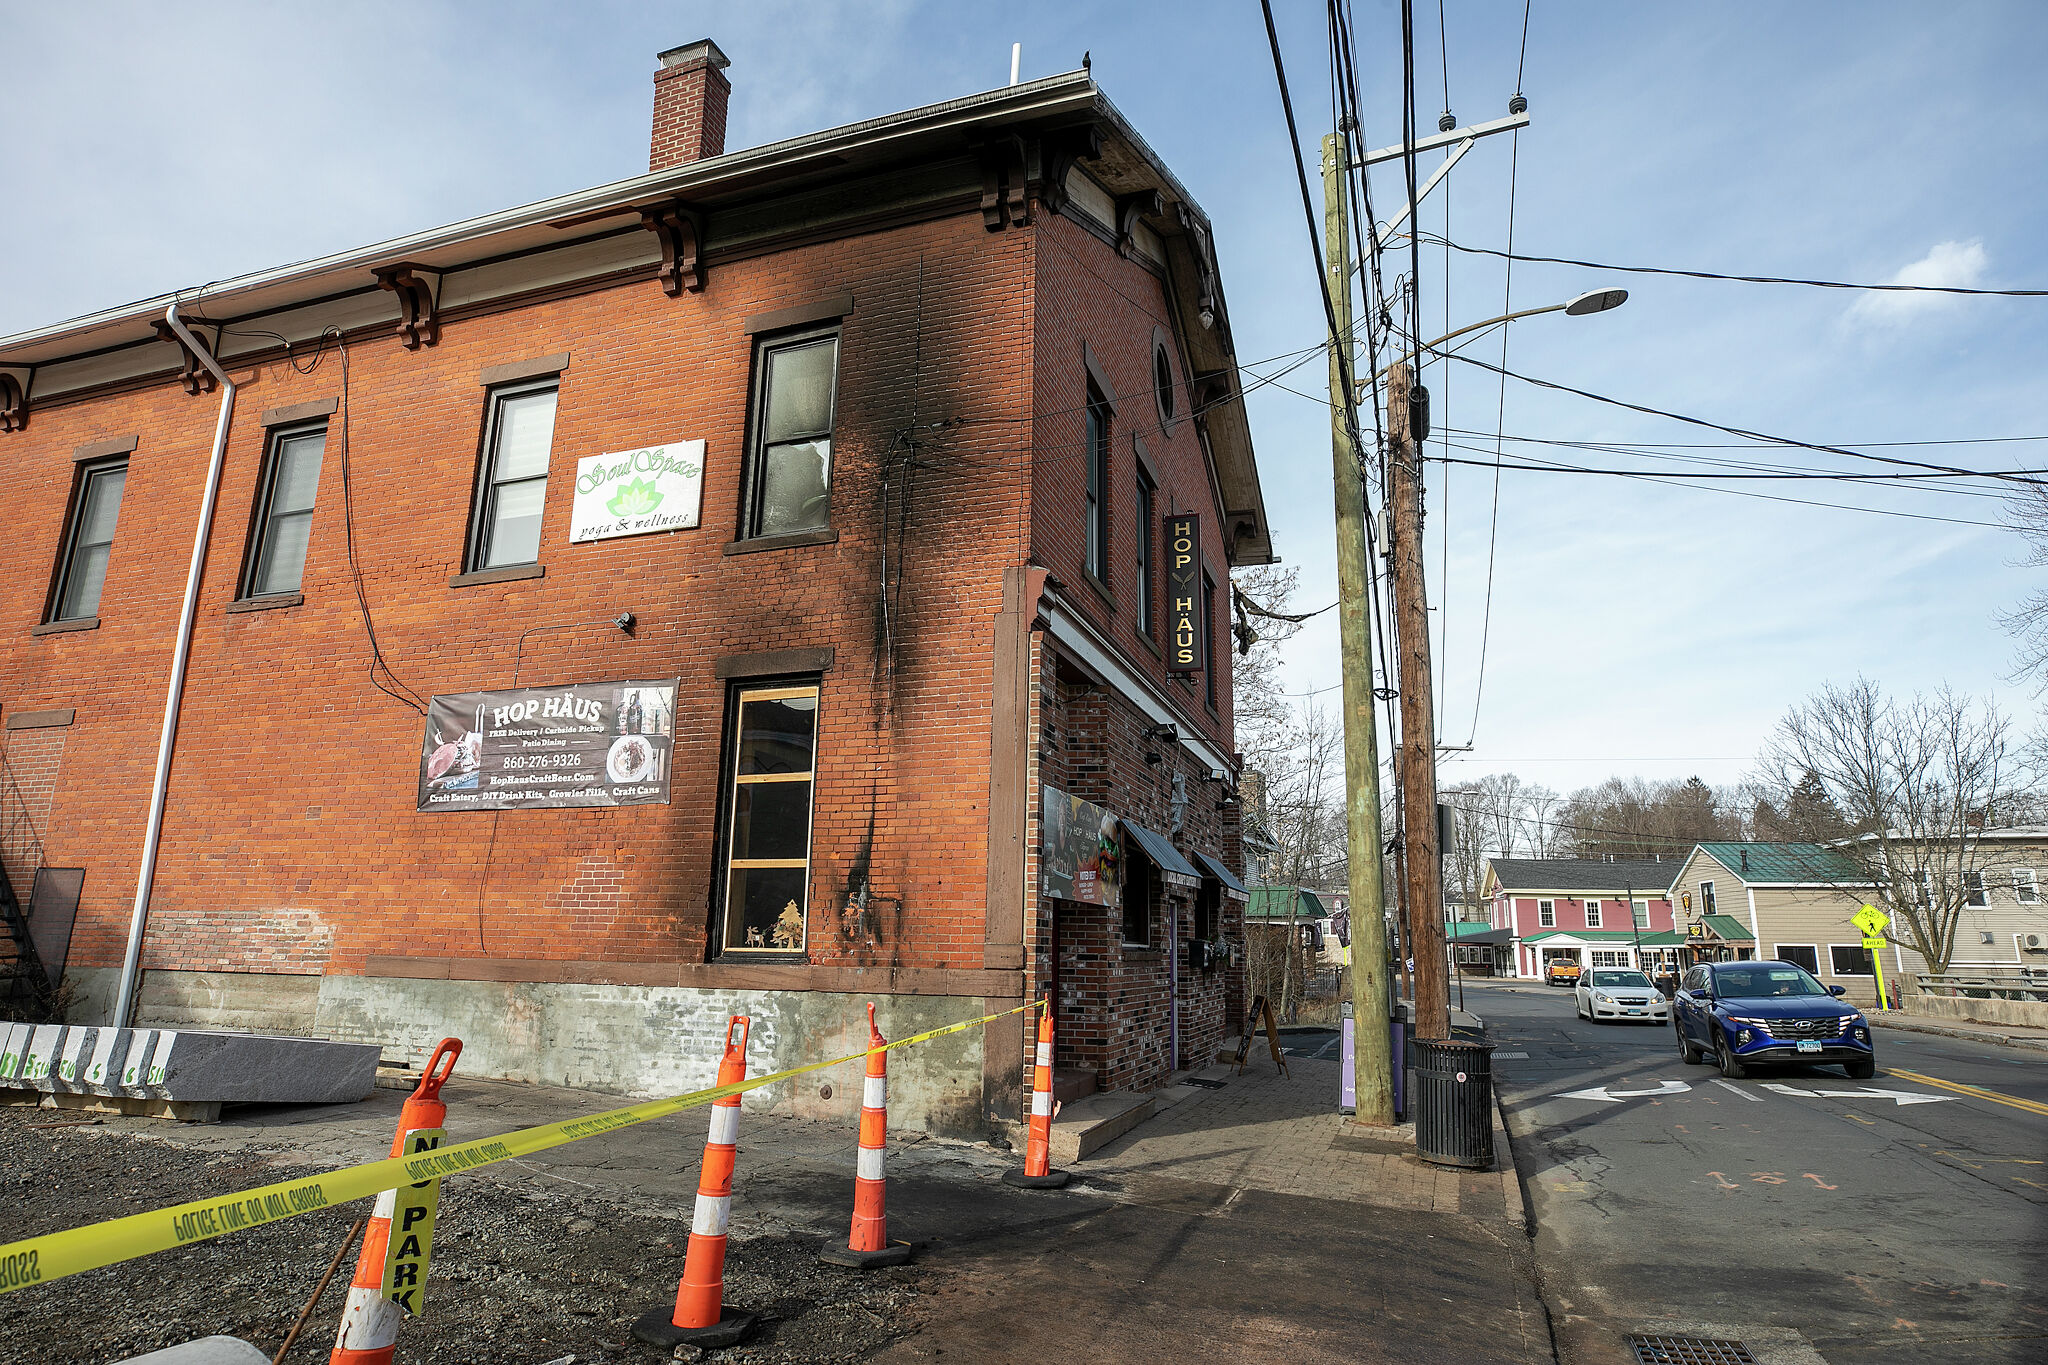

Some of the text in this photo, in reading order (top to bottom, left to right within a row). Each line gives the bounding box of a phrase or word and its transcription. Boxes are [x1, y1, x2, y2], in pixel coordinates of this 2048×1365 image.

[577, 448, 701, 494] Soul Space
[579, 513, 689, 540] yoga & wellness
[1173, 521, 1192, 569] HOP
[1175, 596, 1194, 664] HÄUS
[493, 692, 603, 728] HOP HÄUS
[489, 725, 604, 737] FREE Delivery / Curbside Pickup
[542, 738, 566, 746] Dining
[503, 753, 581, 769] 860-276-9326
[430, 785, 660, 803] Craft Eatery, DIY Drink Kits, Growler Fills, Craft Cans
[126, 1066, 135, 1083] 6
